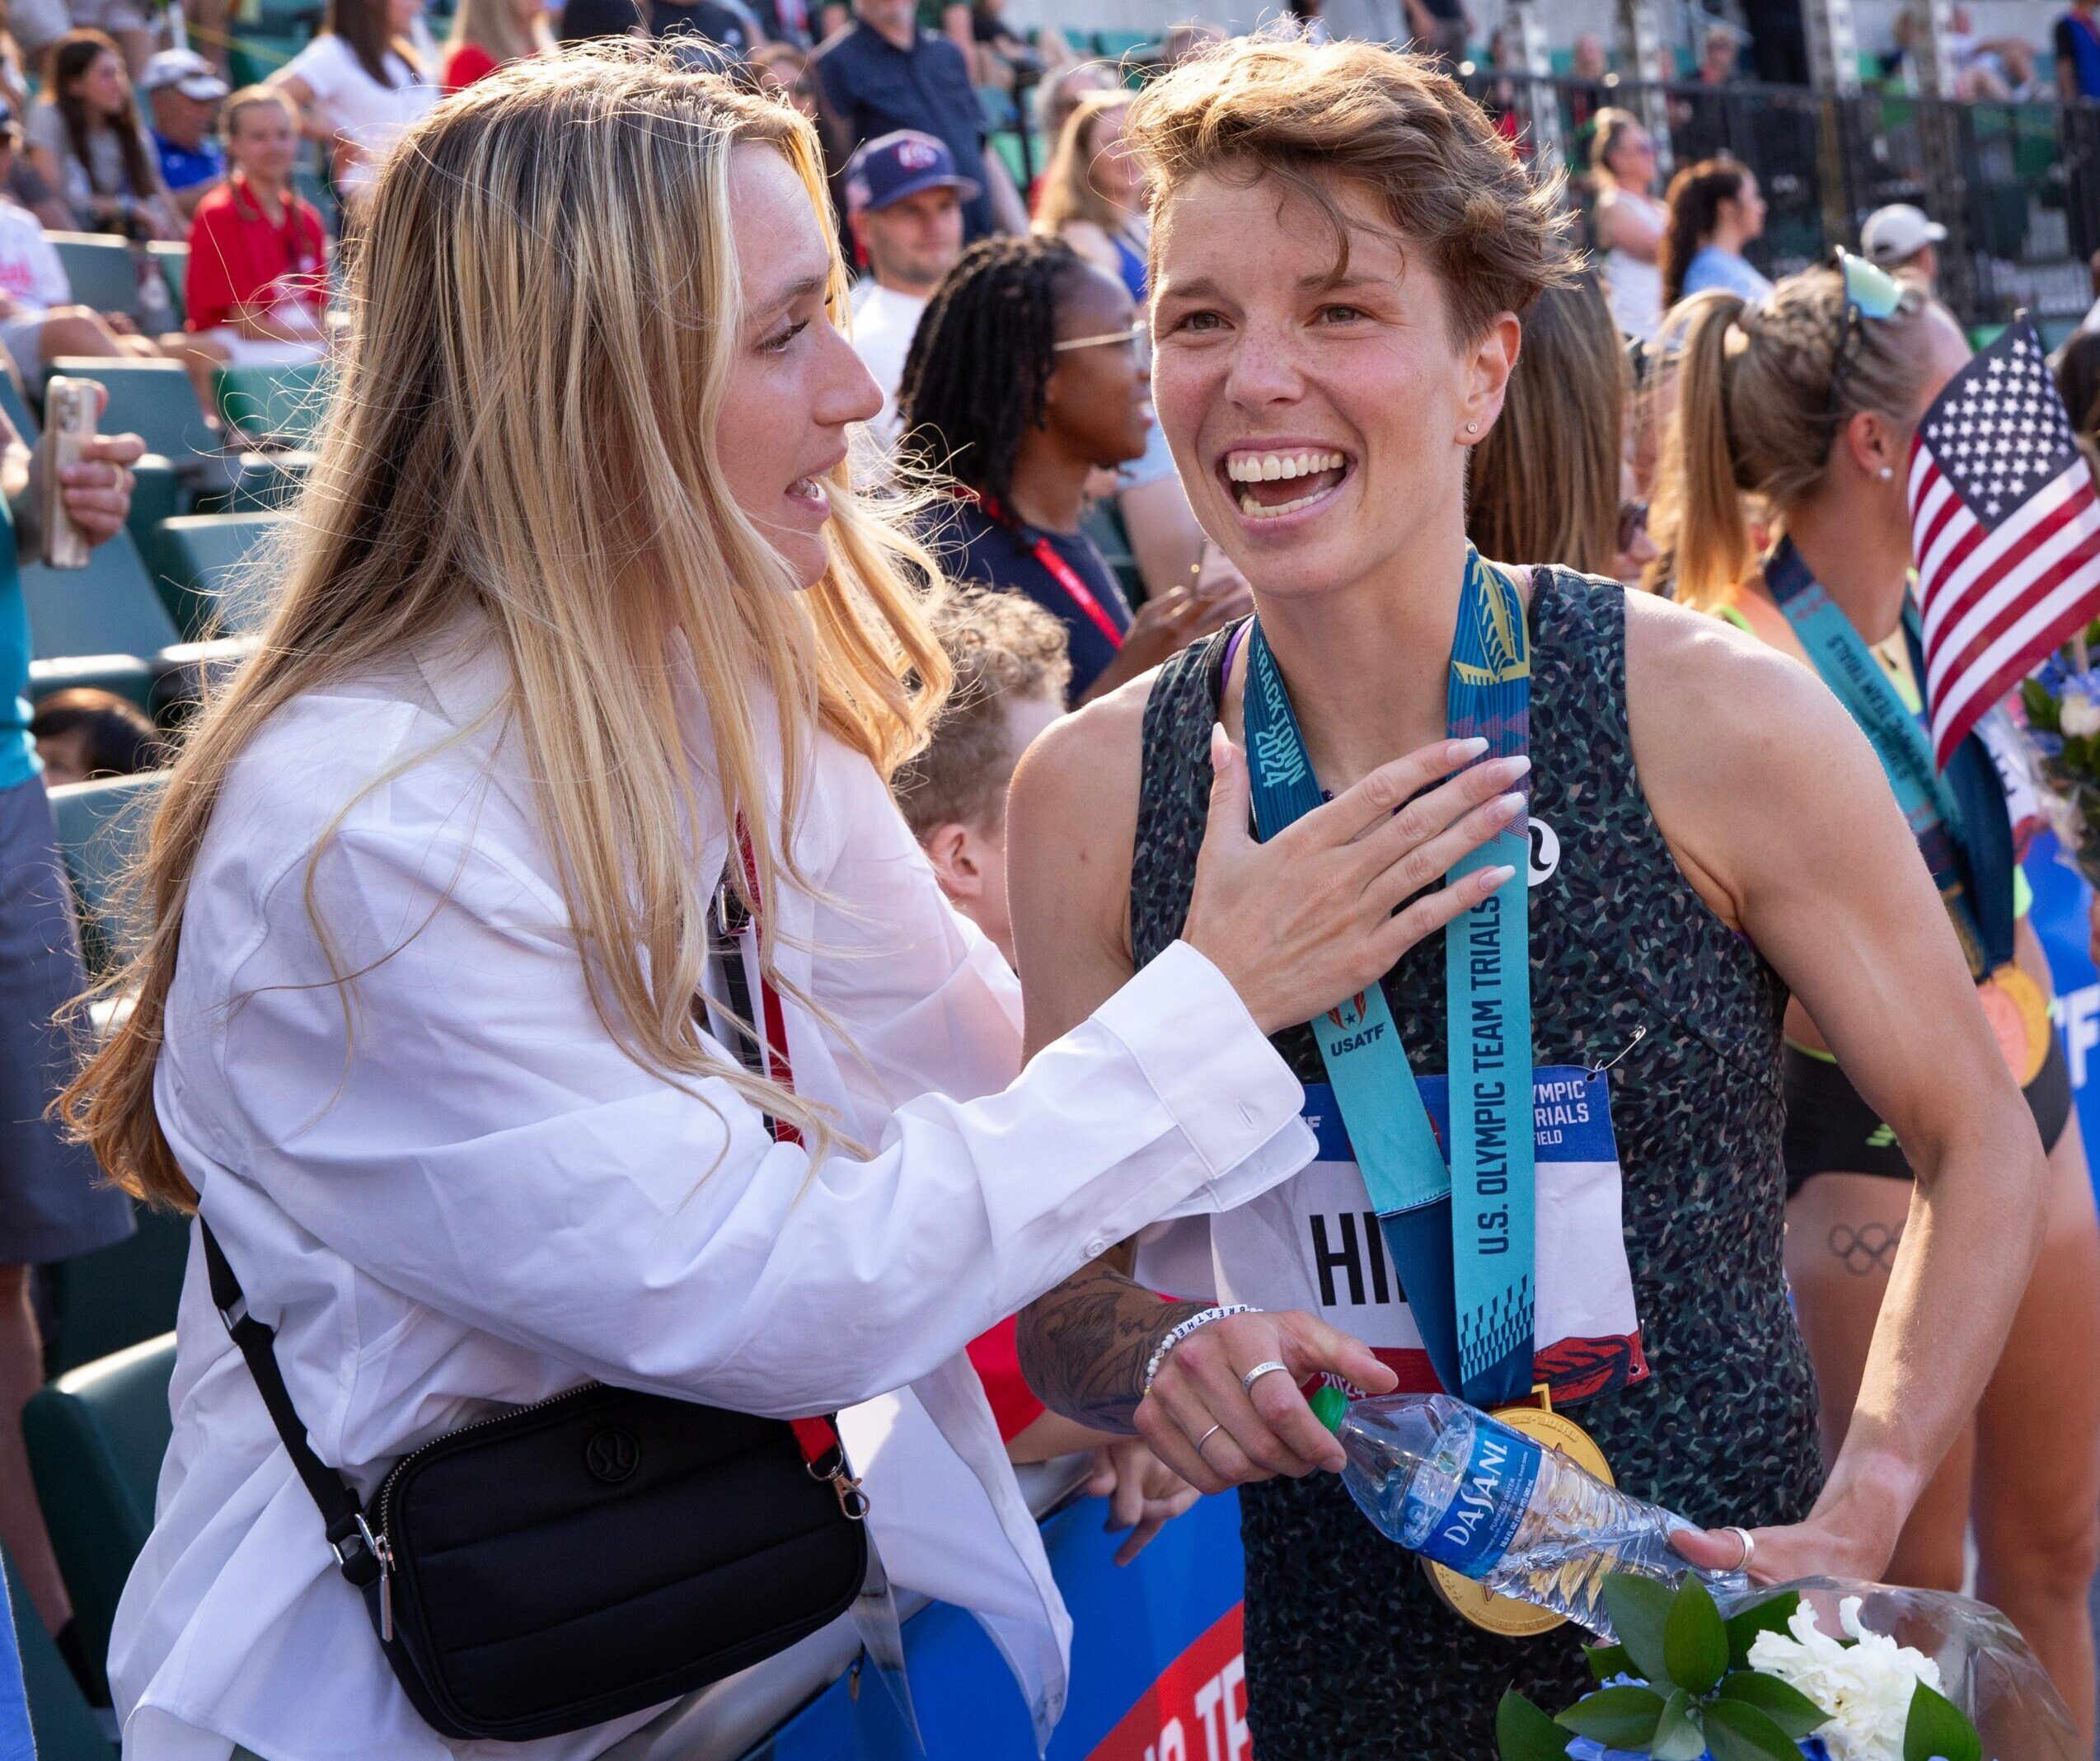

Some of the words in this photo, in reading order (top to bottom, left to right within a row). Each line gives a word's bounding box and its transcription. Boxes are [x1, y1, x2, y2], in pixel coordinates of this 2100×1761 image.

[1257, 638, 1306, 786] TRACKTOWN
[1255, 724, 1290, 789] 2024
[1470, 895, 1502, 991] TRIALS
[1330, 1022, 1385, 1056] USATF
[1471, 1000, 1504, 1074] TEAM
[1474, 1081, 1507, 1196] OLYMPIC
[1309, 1211, 1408, 1306] HI
[1478, 1203, 1509, 1255] U.S.
[1179, 1306, 1245, 1337] BREATHE
[1444, 1440, 1507, 1547] DASANI
[1489, 1501, 1507, 1531] PURIFIED
[1503, 1477, 1516, 1501] WATER
[1499, 1535, 1511, 1548] 16.9
[1509, 1520, 1518, 1530] OZ
[1522, 1486, 1530, 1497] 500
